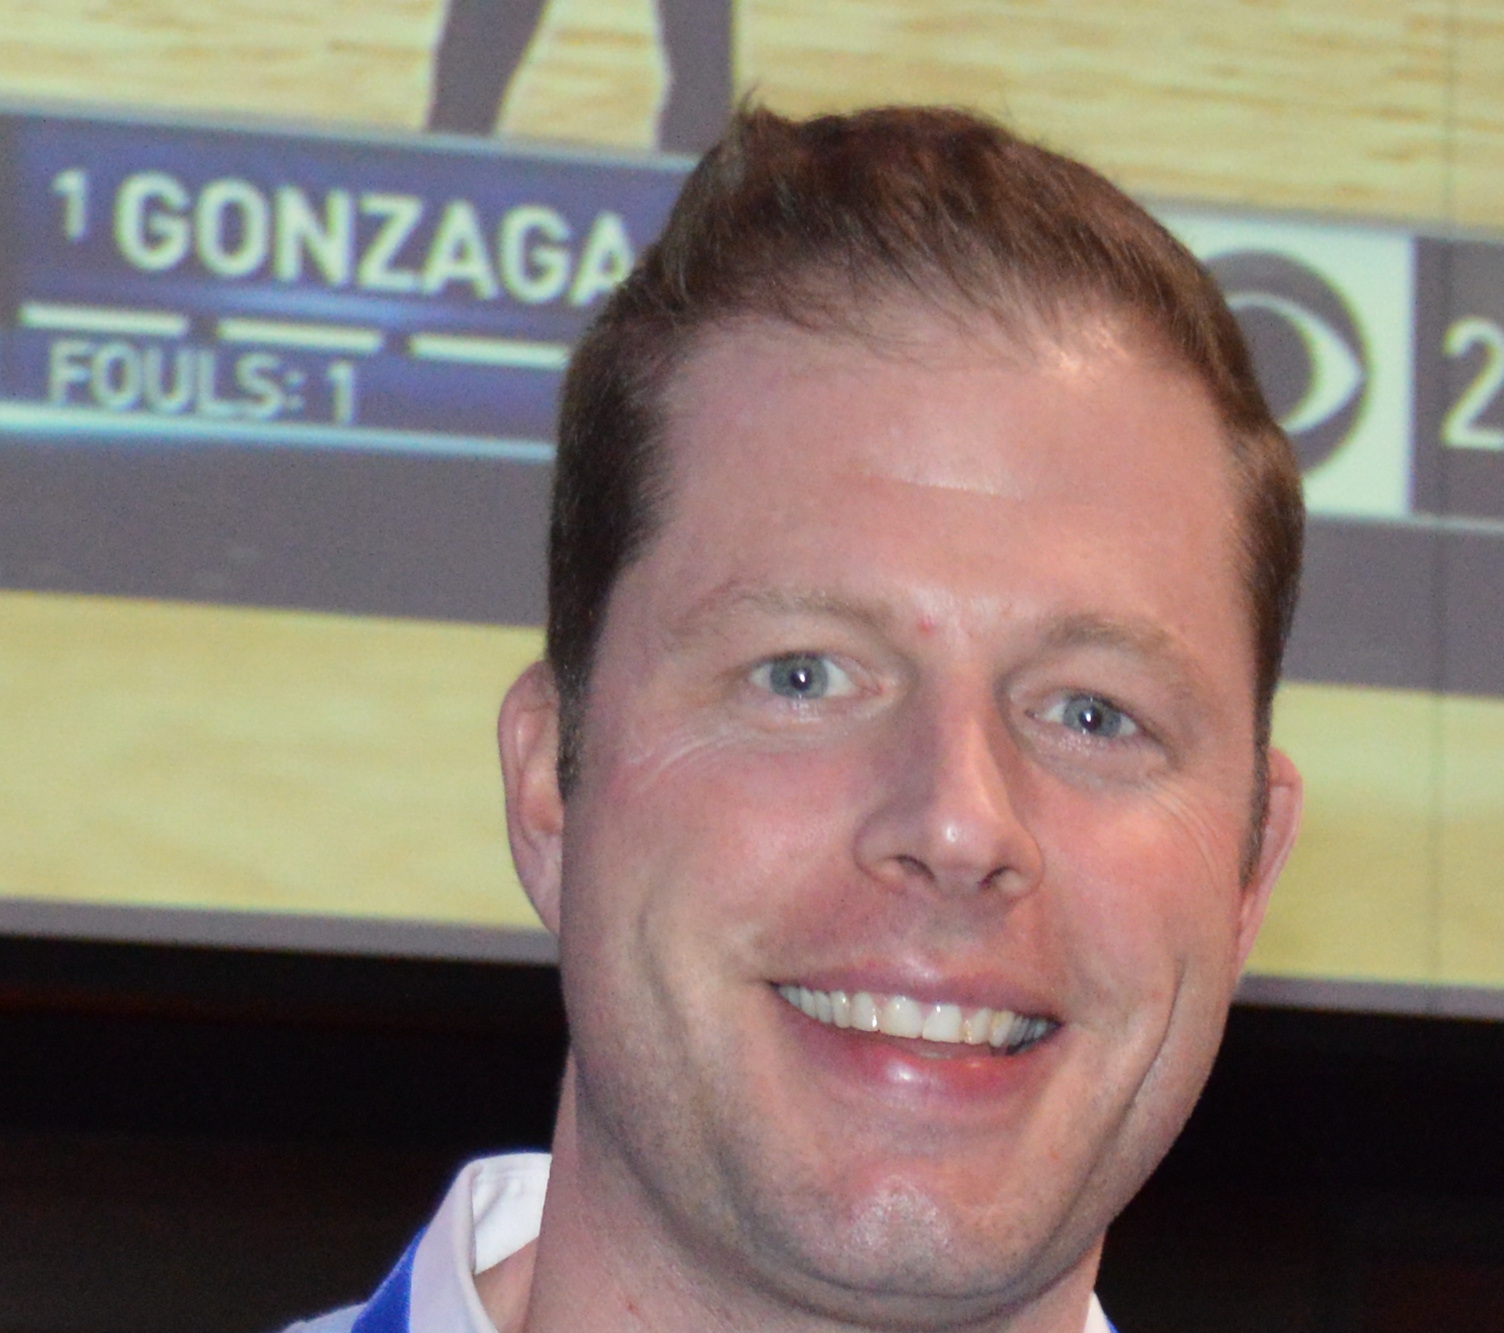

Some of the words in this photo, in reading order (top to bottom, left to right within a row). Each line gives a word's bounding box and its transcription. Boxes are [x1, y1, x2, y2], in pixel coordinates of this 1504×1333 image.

[50, 169, 88, 242] 1
[114, 170, 635, 307] GONZAGA
[48, 338, 308, 420] FOULS:
[325, 361, 358, 427] 1
